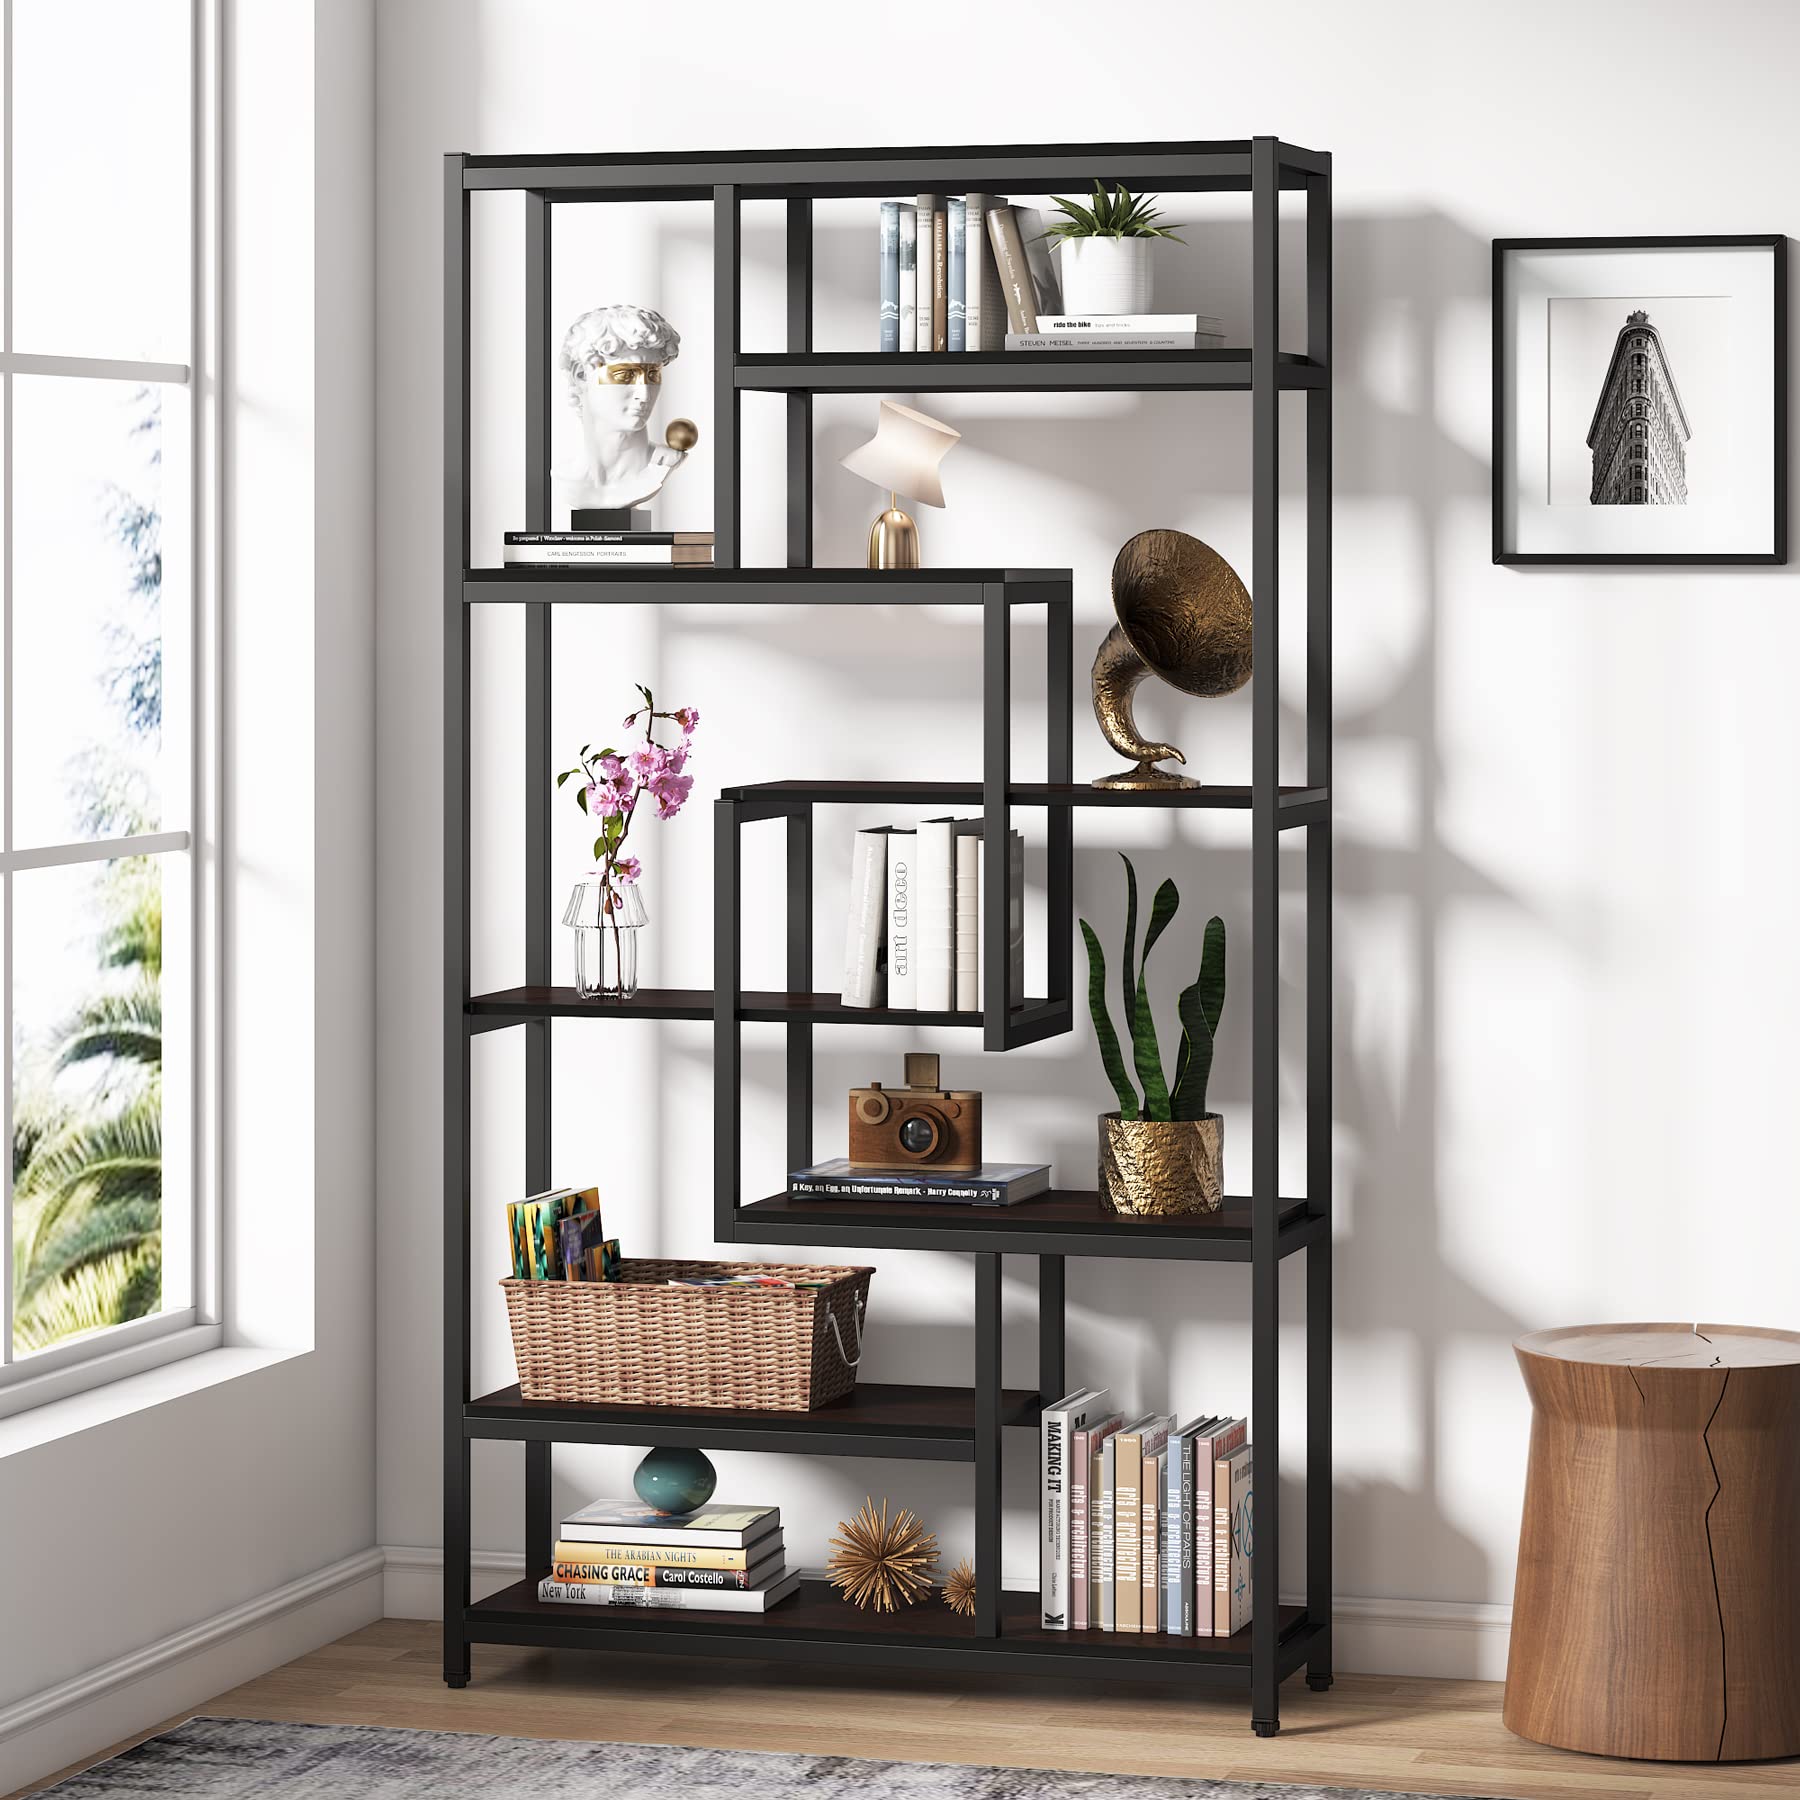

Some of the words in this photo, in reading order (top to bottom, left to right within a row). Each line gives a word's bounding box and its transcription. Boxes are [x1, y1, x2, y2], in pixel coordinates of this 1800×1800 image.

[936, 262, 944, 299] Revolution
[893, 861, 908, 928] deco
[893, 934, 908, 976] art
[894, 1186, 922, 1195] Remark
[927, 1188, 946, 1197] Harry
[948, 1188, 978, 1198] Connolly
[1047, 1421, 1061, 1476] MAKING
[1183, 1445, 1191, 1470] THE
[1047, 1479, 1061, 1493] IT
[1071, 1484, 1087, 1504] arts
[1116, 1487, 1140, 1506] arts
[1168, 1489, 1181, 1508] arts
[1183, 1472, 1191, 1510] LIGHT
[1143, 1504, 1157, 1521] arts
[1196, 1490, 1212, 1510] arts
[1183, 1512, 1191, 1530] OF
[1214, 1507, 1229, 1525] arts
[605, 1549, 622, 1559] THE
[625, 1550, 661, 1561] ARABIAN
[664, 1551, 697, 1563] NIGHTS
[1071, 1519, 1087, 1579] architecture
[1116, 1521, 1141, 1581] architecture
[1143, 1535, 1157, 1588] architecture
[1168, 1524, 1181, 1583] architecture
[1183, 1532, 1191, 1569] PARIS
[1196, 1526, 1212, 1585] architecture
[556, 1564, 608, 1580] CHASING
[611, 1566, 650, 1581] GRACE
[662, 1569, 686, 1583] Carol
[688, 1570, 724, 1584] Costello
[1214, 1539, 1230, 1592] architecture
[542, 1583, 562, 1598] New
[565, 1583, 586, 1600] York
